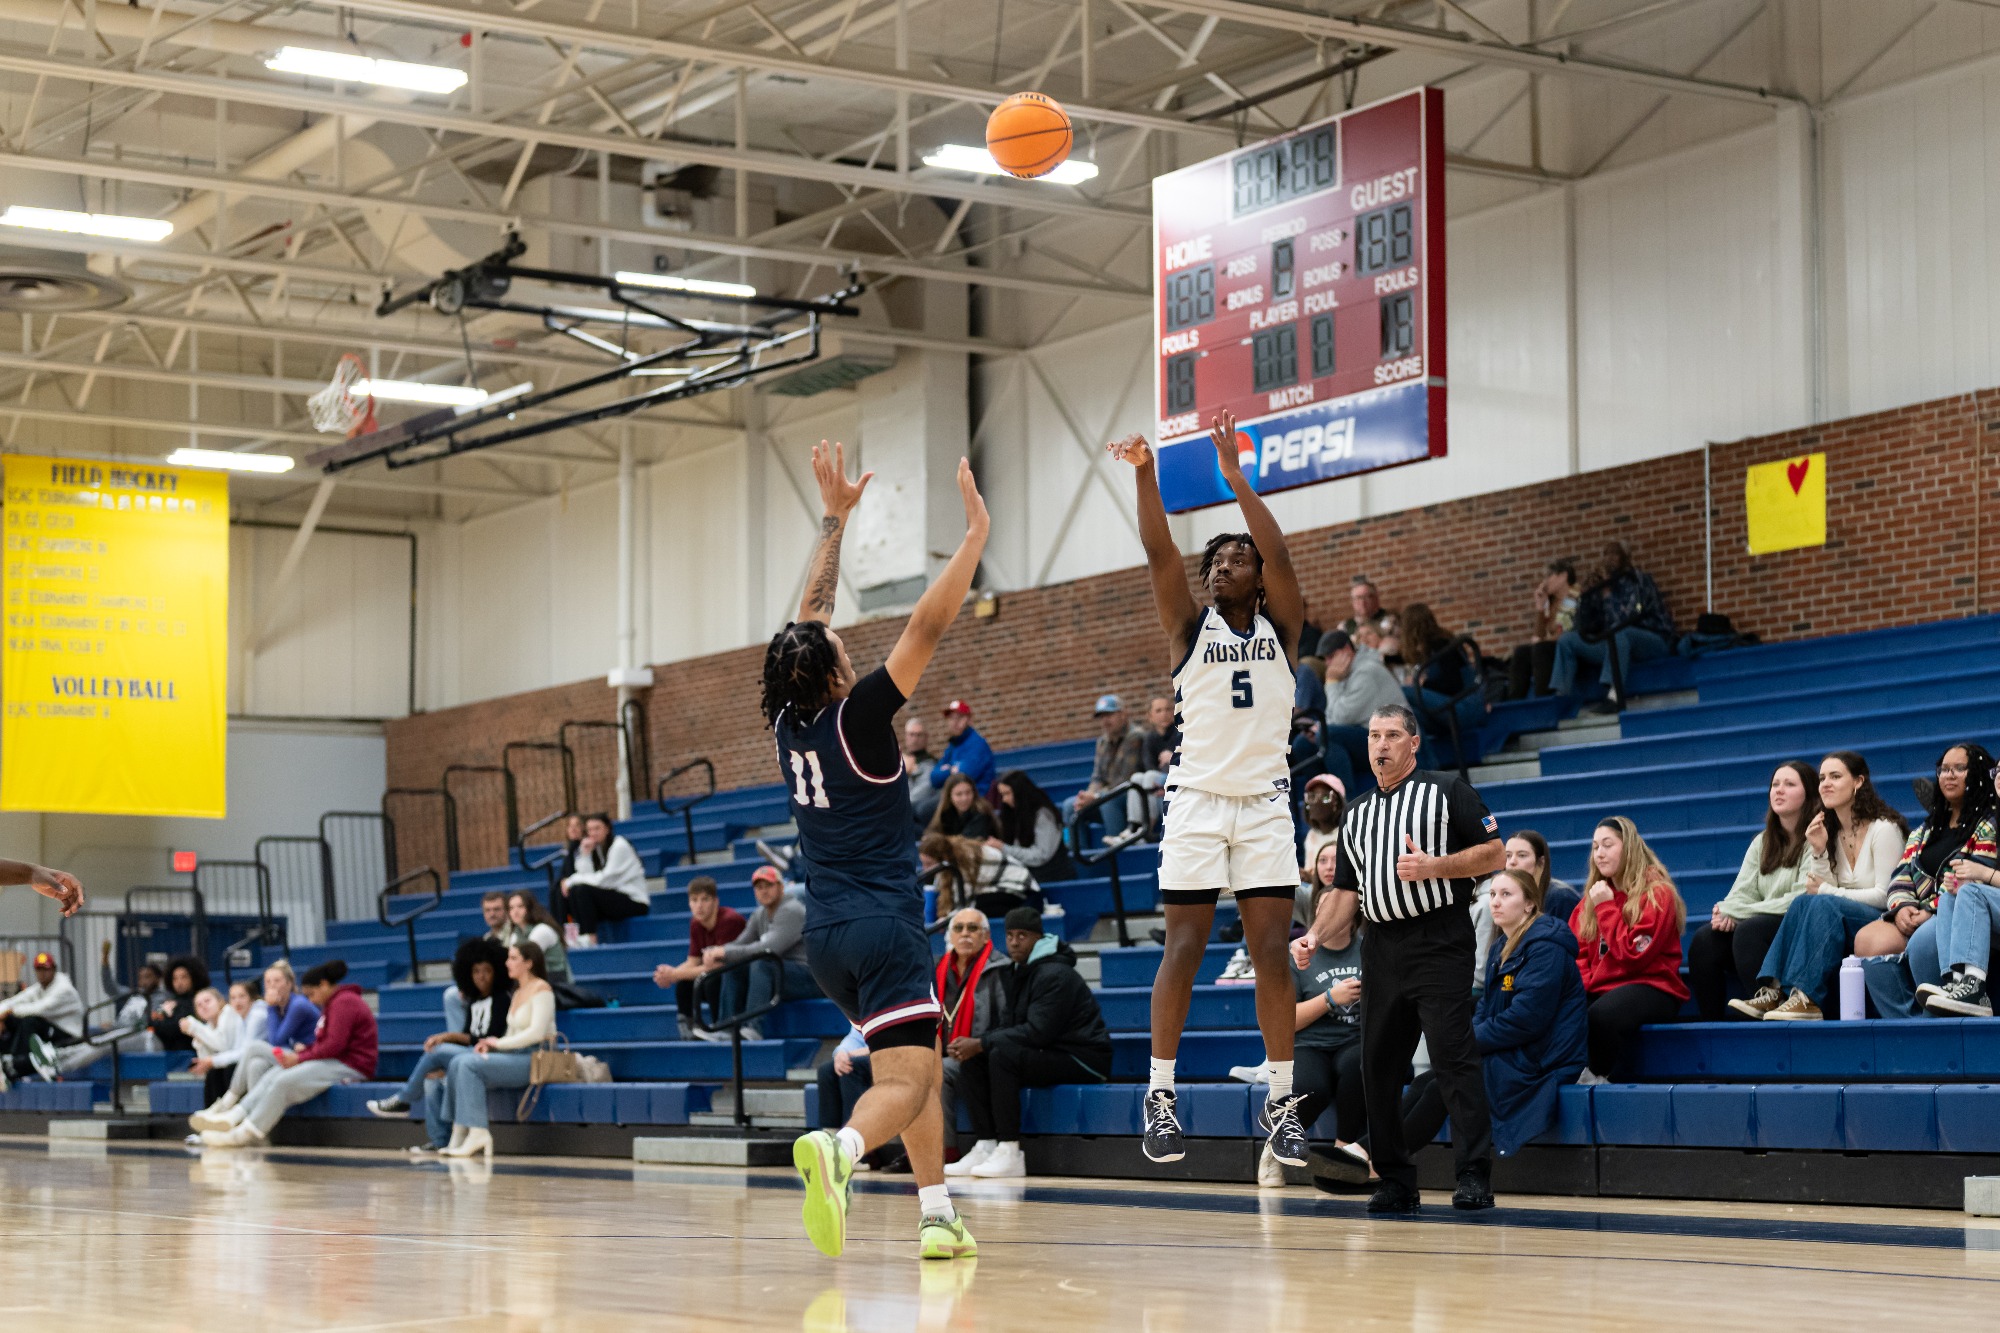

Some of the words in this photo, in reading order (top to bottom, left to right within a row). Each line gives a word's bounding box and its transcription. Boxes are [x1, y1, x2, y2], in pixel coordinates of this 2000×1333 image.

[1351, 167, 1418, 211] GUEST
[1166, 234, 1213, 271] HOME
[1309, 228, 1341, 253] POSS
[1374, 267, 1419, 295] FOULS
[1227, 284, 1264, 311] BONUS
[1249, 300, 1299, 330] PLAYER
[1303, 290, 1340, 315] FOUL
[1161, 329, 1200, 356] FOULS
[1373, 356, 1423, 385] SCORE
[1268, 384, 1315, 411] MATCH
[1158, 412, 1200, 440] SCORE
[1259, 416, 1356, 478] PEPSI
[51, 464, 103, 487] FIELD
[1203, 637, 1277, 664] HUSKIES
[51, 673, 180, 703] VOLLEYBALL
[1231, 670, 1254, 709] 5
[789, 749, 831, 808] 11
[1328, 966, 1358, 977] YEARS
